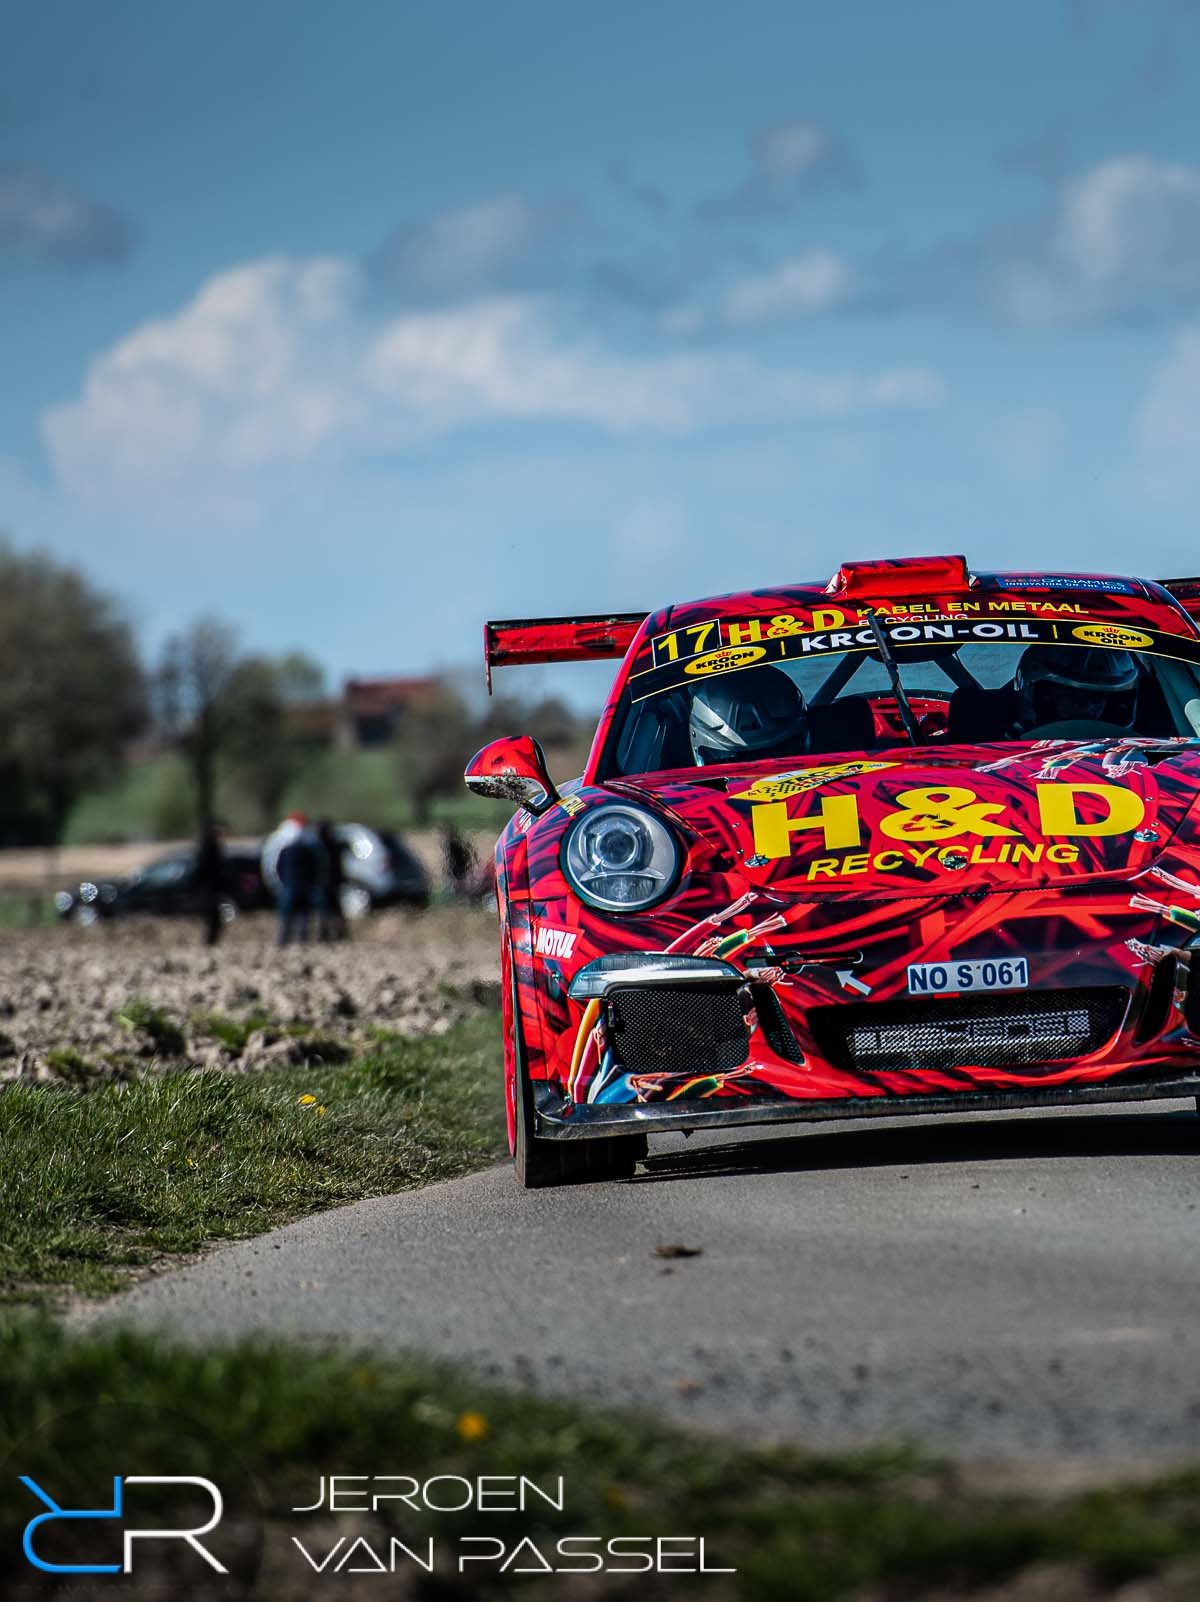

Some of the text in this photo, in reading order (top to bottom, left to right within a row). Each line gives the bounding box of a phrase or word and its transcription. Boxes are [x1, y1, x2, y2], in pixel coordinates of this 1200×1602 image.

[856, 602, 1090, 618] KABEL EN METAAL
[728, 609, 846, 646] H&D
[801, 623, 1039, 652] KROON-OIL
[1083, 630, 1143, 643] KROON
[657, 622, 716, 662] 17
[1100, 637, 1127, 646] OIL
[695, 651, 754, 670] KROON
[712, 661, 738, 671] OIL
[536, 927, 577, 959] MOTUL
[909, 960, 1027, 992] NO S 061
